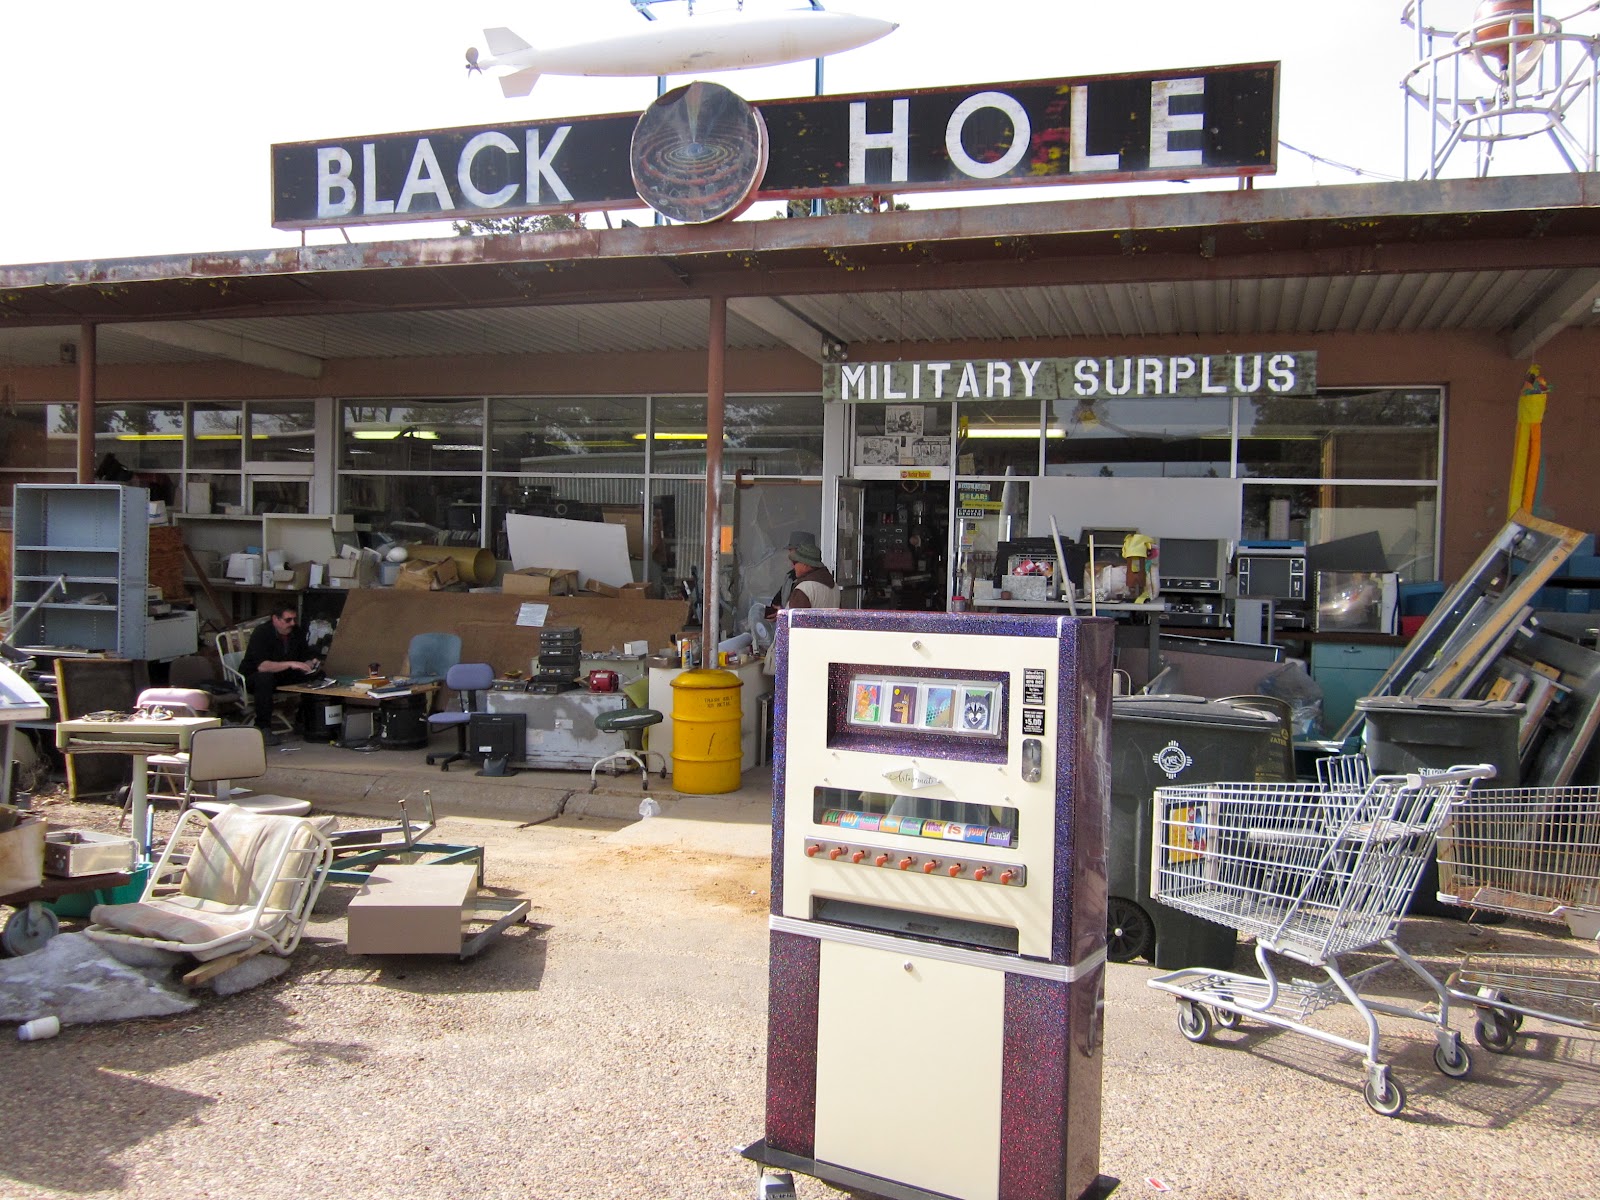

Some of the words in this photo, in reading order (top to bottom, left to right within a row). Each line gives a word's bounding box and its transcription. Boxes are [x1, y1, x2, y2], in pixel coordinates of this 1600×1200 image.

[316, 125, 574, 219] BLACK
[849, 77, 1205, 184] HOLE
[841, 360, 1042, 400] MILITARY
[1074, 354, 1295, 396] SURPLUS
[843, 812, 859, 826] My
[947, 824, 961, 834] is
[967, 827, 985, 837] your
